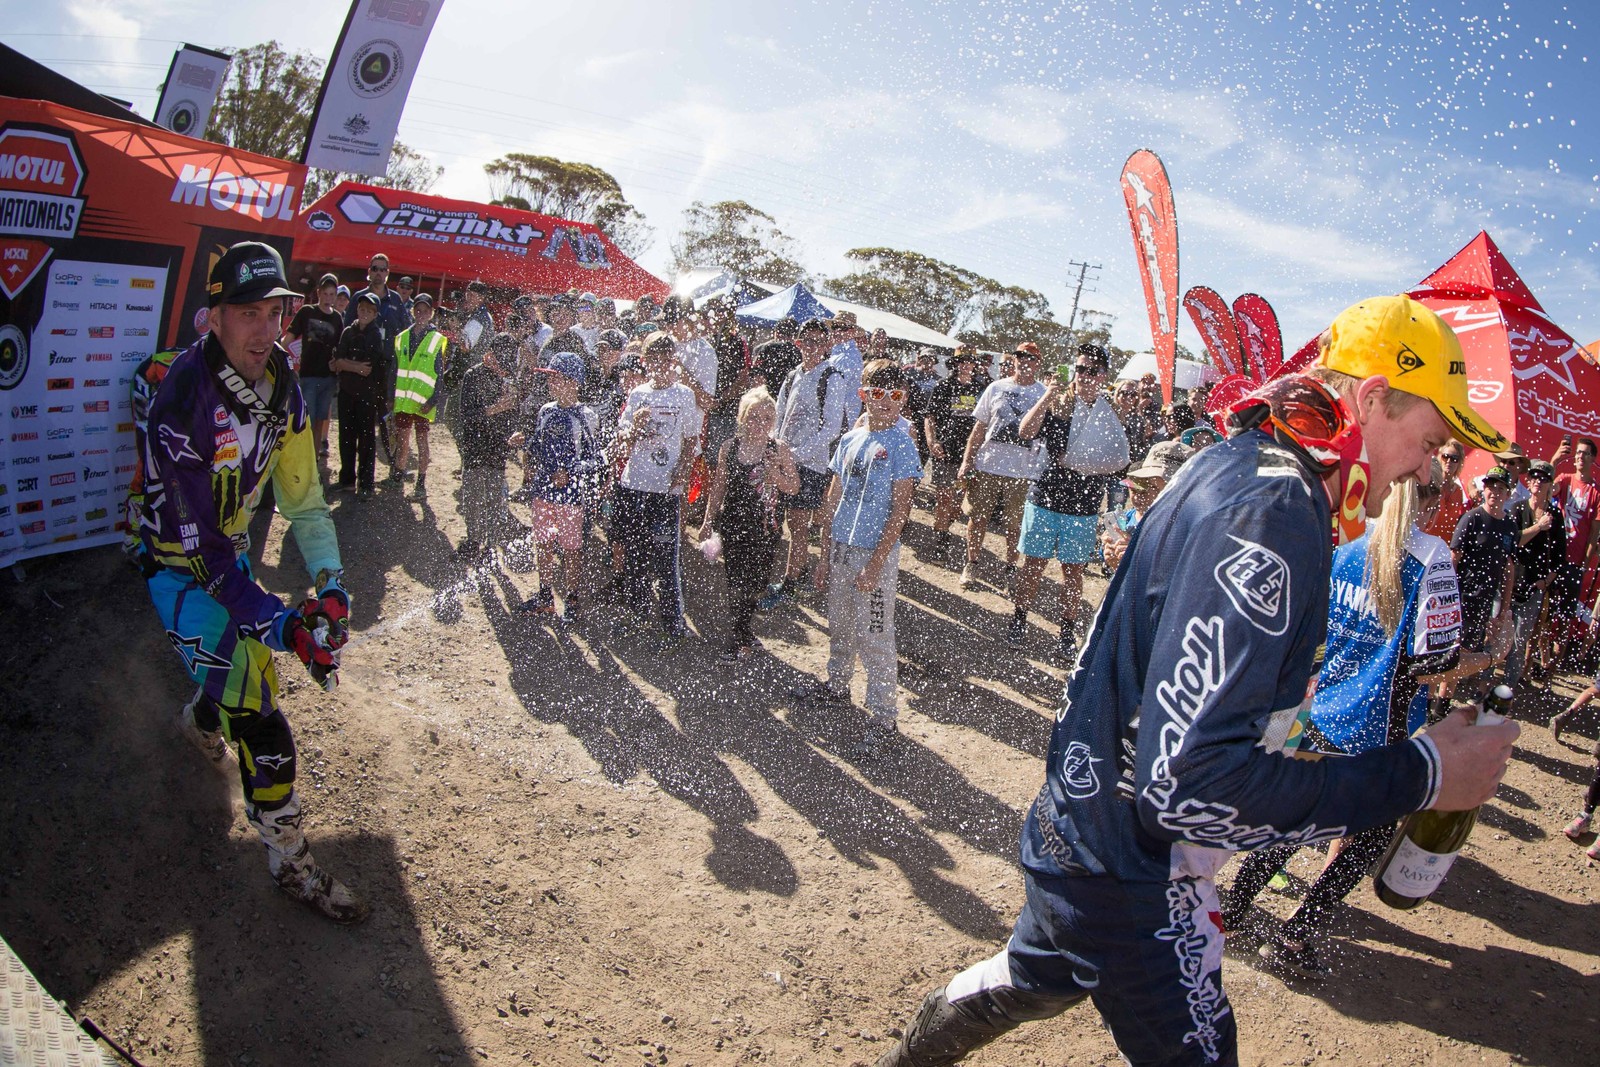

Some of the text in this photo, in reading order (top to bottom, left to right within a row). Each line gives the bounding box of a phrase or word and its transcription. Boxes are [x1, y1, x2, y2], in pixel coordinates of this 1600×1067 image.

[0, 154, 65, 185] MOTUL
[170, 164, 295, 221] MOTUL
[400, 202, 435, 215] protein
[444, 211, 478, 219] energy
[376, 226, 449, 242] Honda
[454, 236, 528, 256] Racing
[4, 248, 28, 260] MXN
[55, 274, 82, 282] GoPro
[90, 302, 117, 310] HITACHI
[55, 354, 76, 364] thor
[217, 364, 272, 423] 100%
[20, 406, 38, 415] YMF
[18, 432, 38, 441] YAMAHA
[47, 428, 74, 436] GoPro
[216, 432, 237, 446] MOTU
[12, 456, 40, 465] HITACHI
[48, 452, 74, 460] Kawasaki
[18, 478, 38, 492] DIRT
[52, 475, 75, 484] MOTUL
[1336, 580, 1377, 620] YAMA
[1438, 595, 1459, 605] YMF
[1429, 616, 1454, 628] NGK
